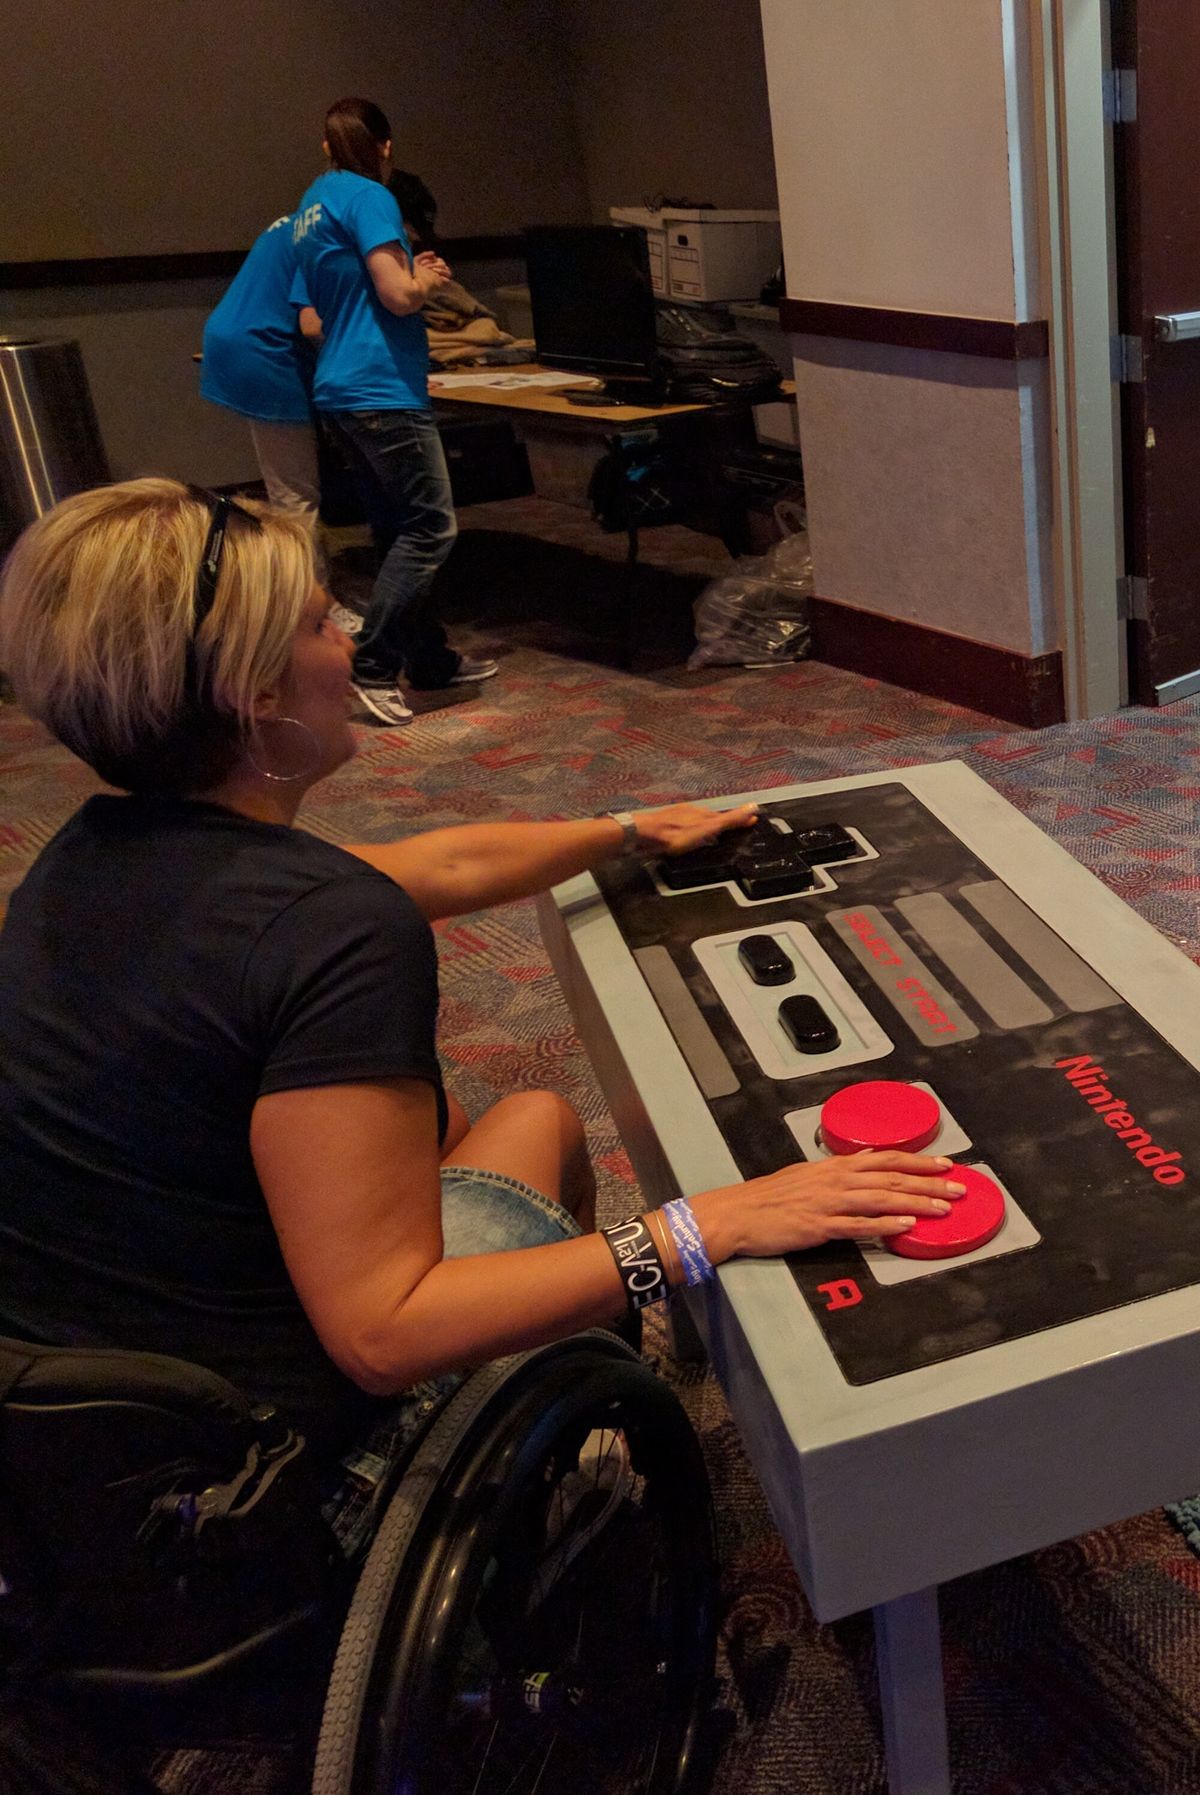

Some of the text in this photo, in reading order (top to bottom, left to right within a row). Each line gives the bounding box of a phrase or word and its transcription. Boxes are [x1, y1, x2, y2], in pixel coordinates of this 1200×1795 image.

[842, 911, 903, 967] SELECT
[896, 976, 958, 1034] START
[1055, 1055, 1185, 1185] Nintendo
[671, 1212, 701, 1252] Saturday
[816, 1278, 864, 1312] A
